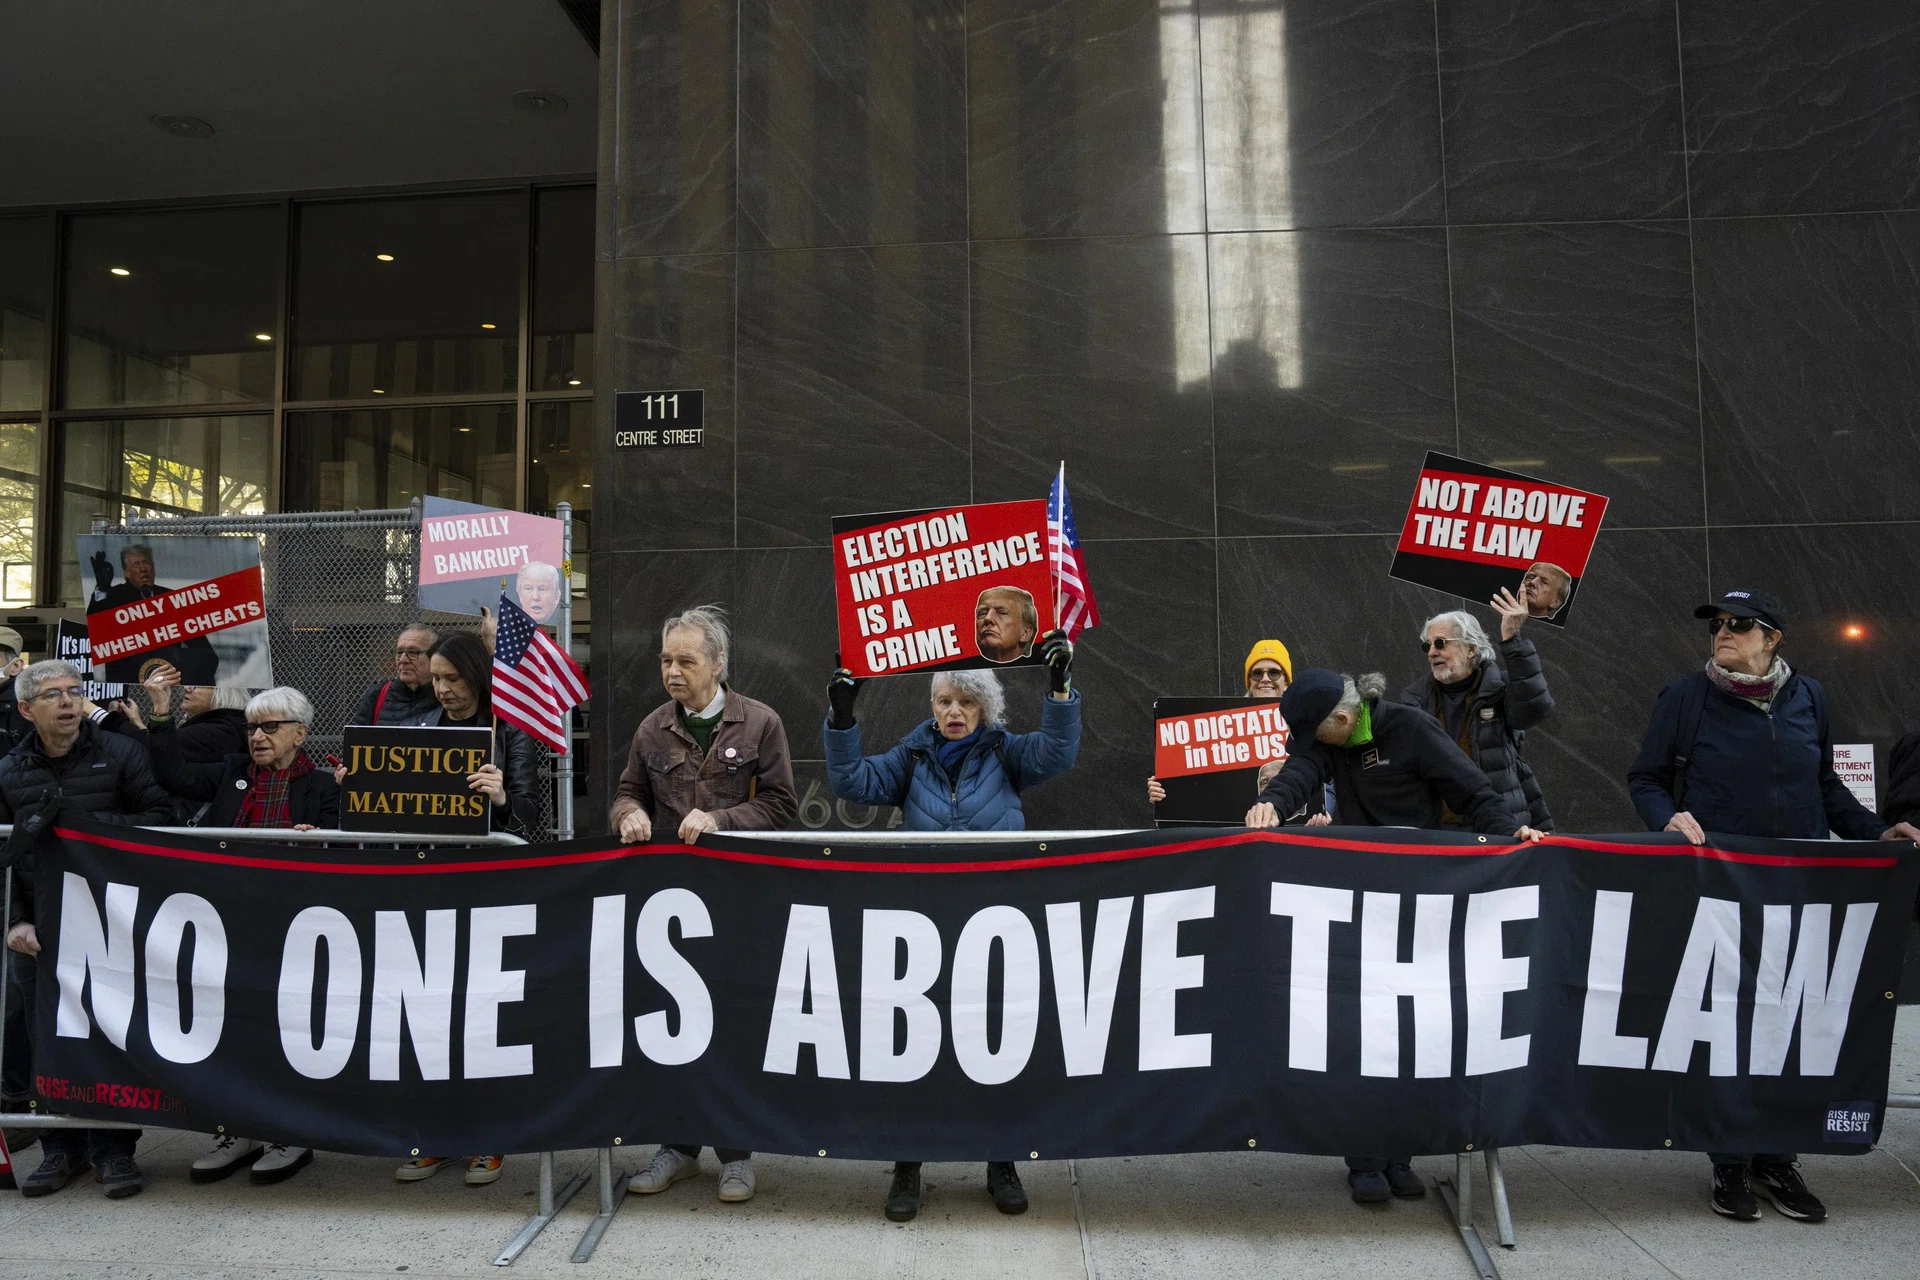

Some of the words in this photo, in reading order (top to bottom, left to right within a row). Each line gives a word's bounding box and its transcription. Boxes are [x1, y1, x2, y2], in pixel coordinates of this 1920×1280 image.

[641, 394, 678, 419] 111
[616, 430, 657, 446] CENTRE
[662, 429, 703, 444] STREET
[1418, 477, 1480, 514] NOT
[1481, 485, 1586, 528] ABOVE
[428, 515, 510, 542] MORALLY
[842, 512, 969, 568] ELECTION
[1414, 514, 1469, 550] THE
[1472, 522, 1543, 560] LAW
[434, 545, 529, 575] BANKRUPT
[849, 532, 1044, 602] INTERFERENCE
[115, 598, 165, 624] ONLY
[168, 583, 221, 609] WINS
[857, 604, 888, 637] IS
[892, 599, 913, 629] A
[61, 635, 77, 655] It's
[92, 631, 150, 659] WHEN
[153, 623, 181, 643] HE
[184, 601, 261, 634] CHEATS
[866, 624, 961, 673] CRIME
[1159, 720, 1190, 747] NO
[1184, 745, 1208, 769] in
[1211, 740, 1250, 765] the
[1253, 732, 1290, 760] US
[347, 745, 485, 776] JUSTICE
[347, 791, 484, 817] MATTERS
[56, 871, 228, 1064] NO
[277, 903, 537, 1081] ONE
[589, 888, 714, 1068] IS
[762, 885, 1216, 1085] ABOVE
[1270, 881, 1539, 1079] THE
[1578, 889, 1879, 1077] LAW
[1827, 1119, 1869, 1132] RESIST
[1828, 1110, 1848, 1120] RISE
[1851, 1111, 1870, 1121] AND
